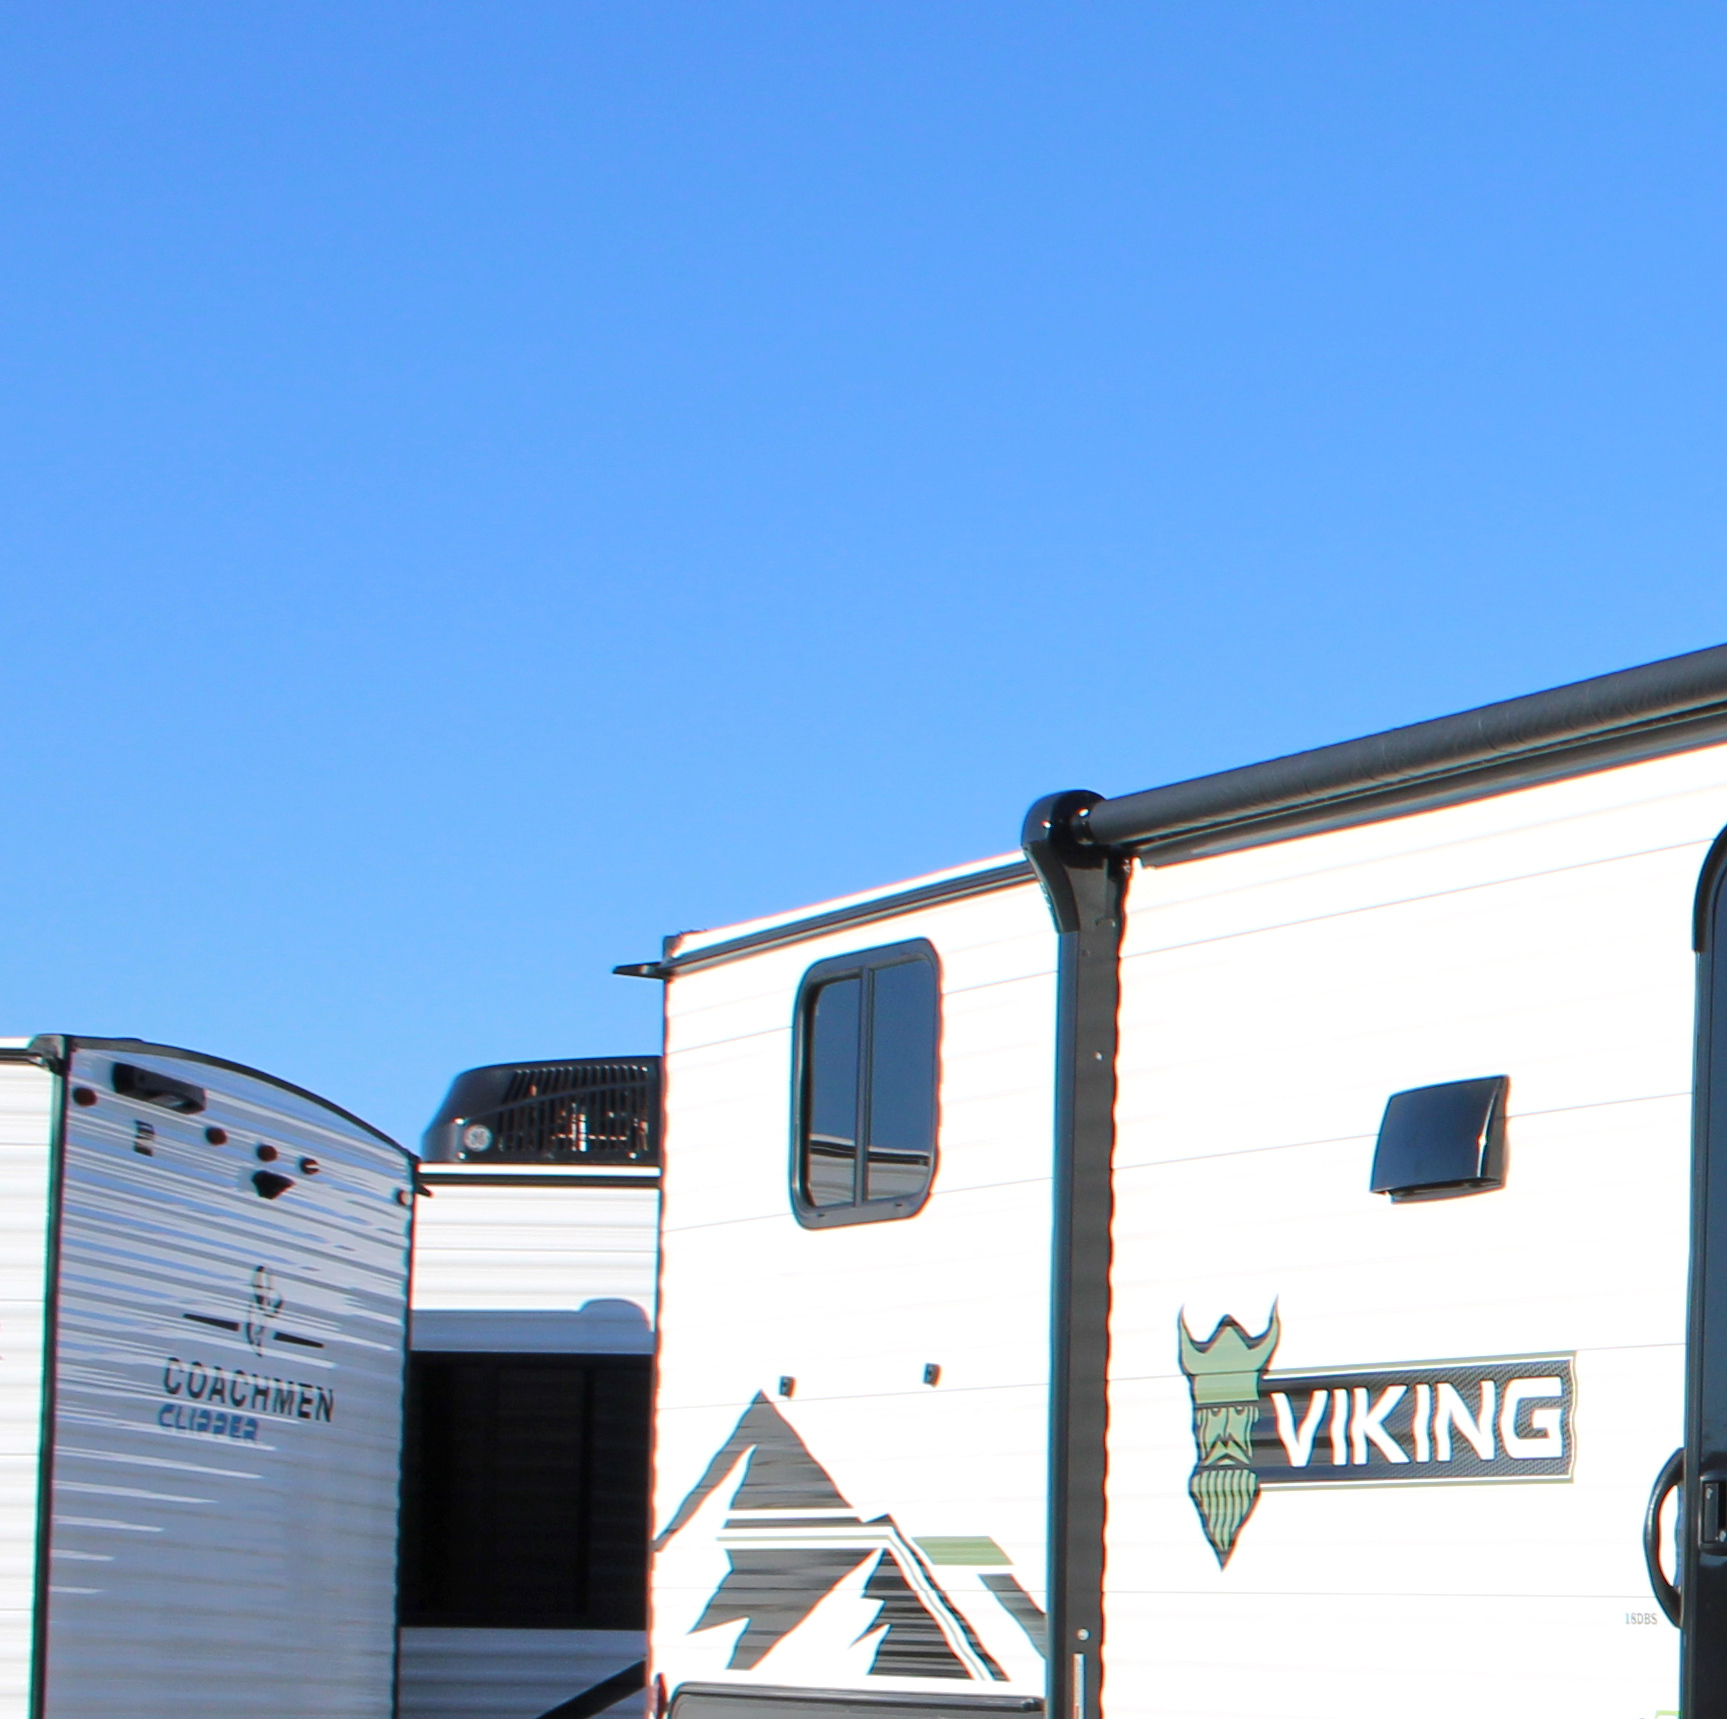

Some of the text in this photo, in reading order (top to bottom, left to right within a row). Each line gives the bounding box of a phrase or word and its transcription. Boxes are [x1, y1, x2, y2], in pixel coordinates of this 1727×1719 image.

[157, 1403, 260, 1443] CLIPPER
[163, 1356, 334, 1423] COACHMEN
[1269, 1375, 1565, 1469] VIKING
